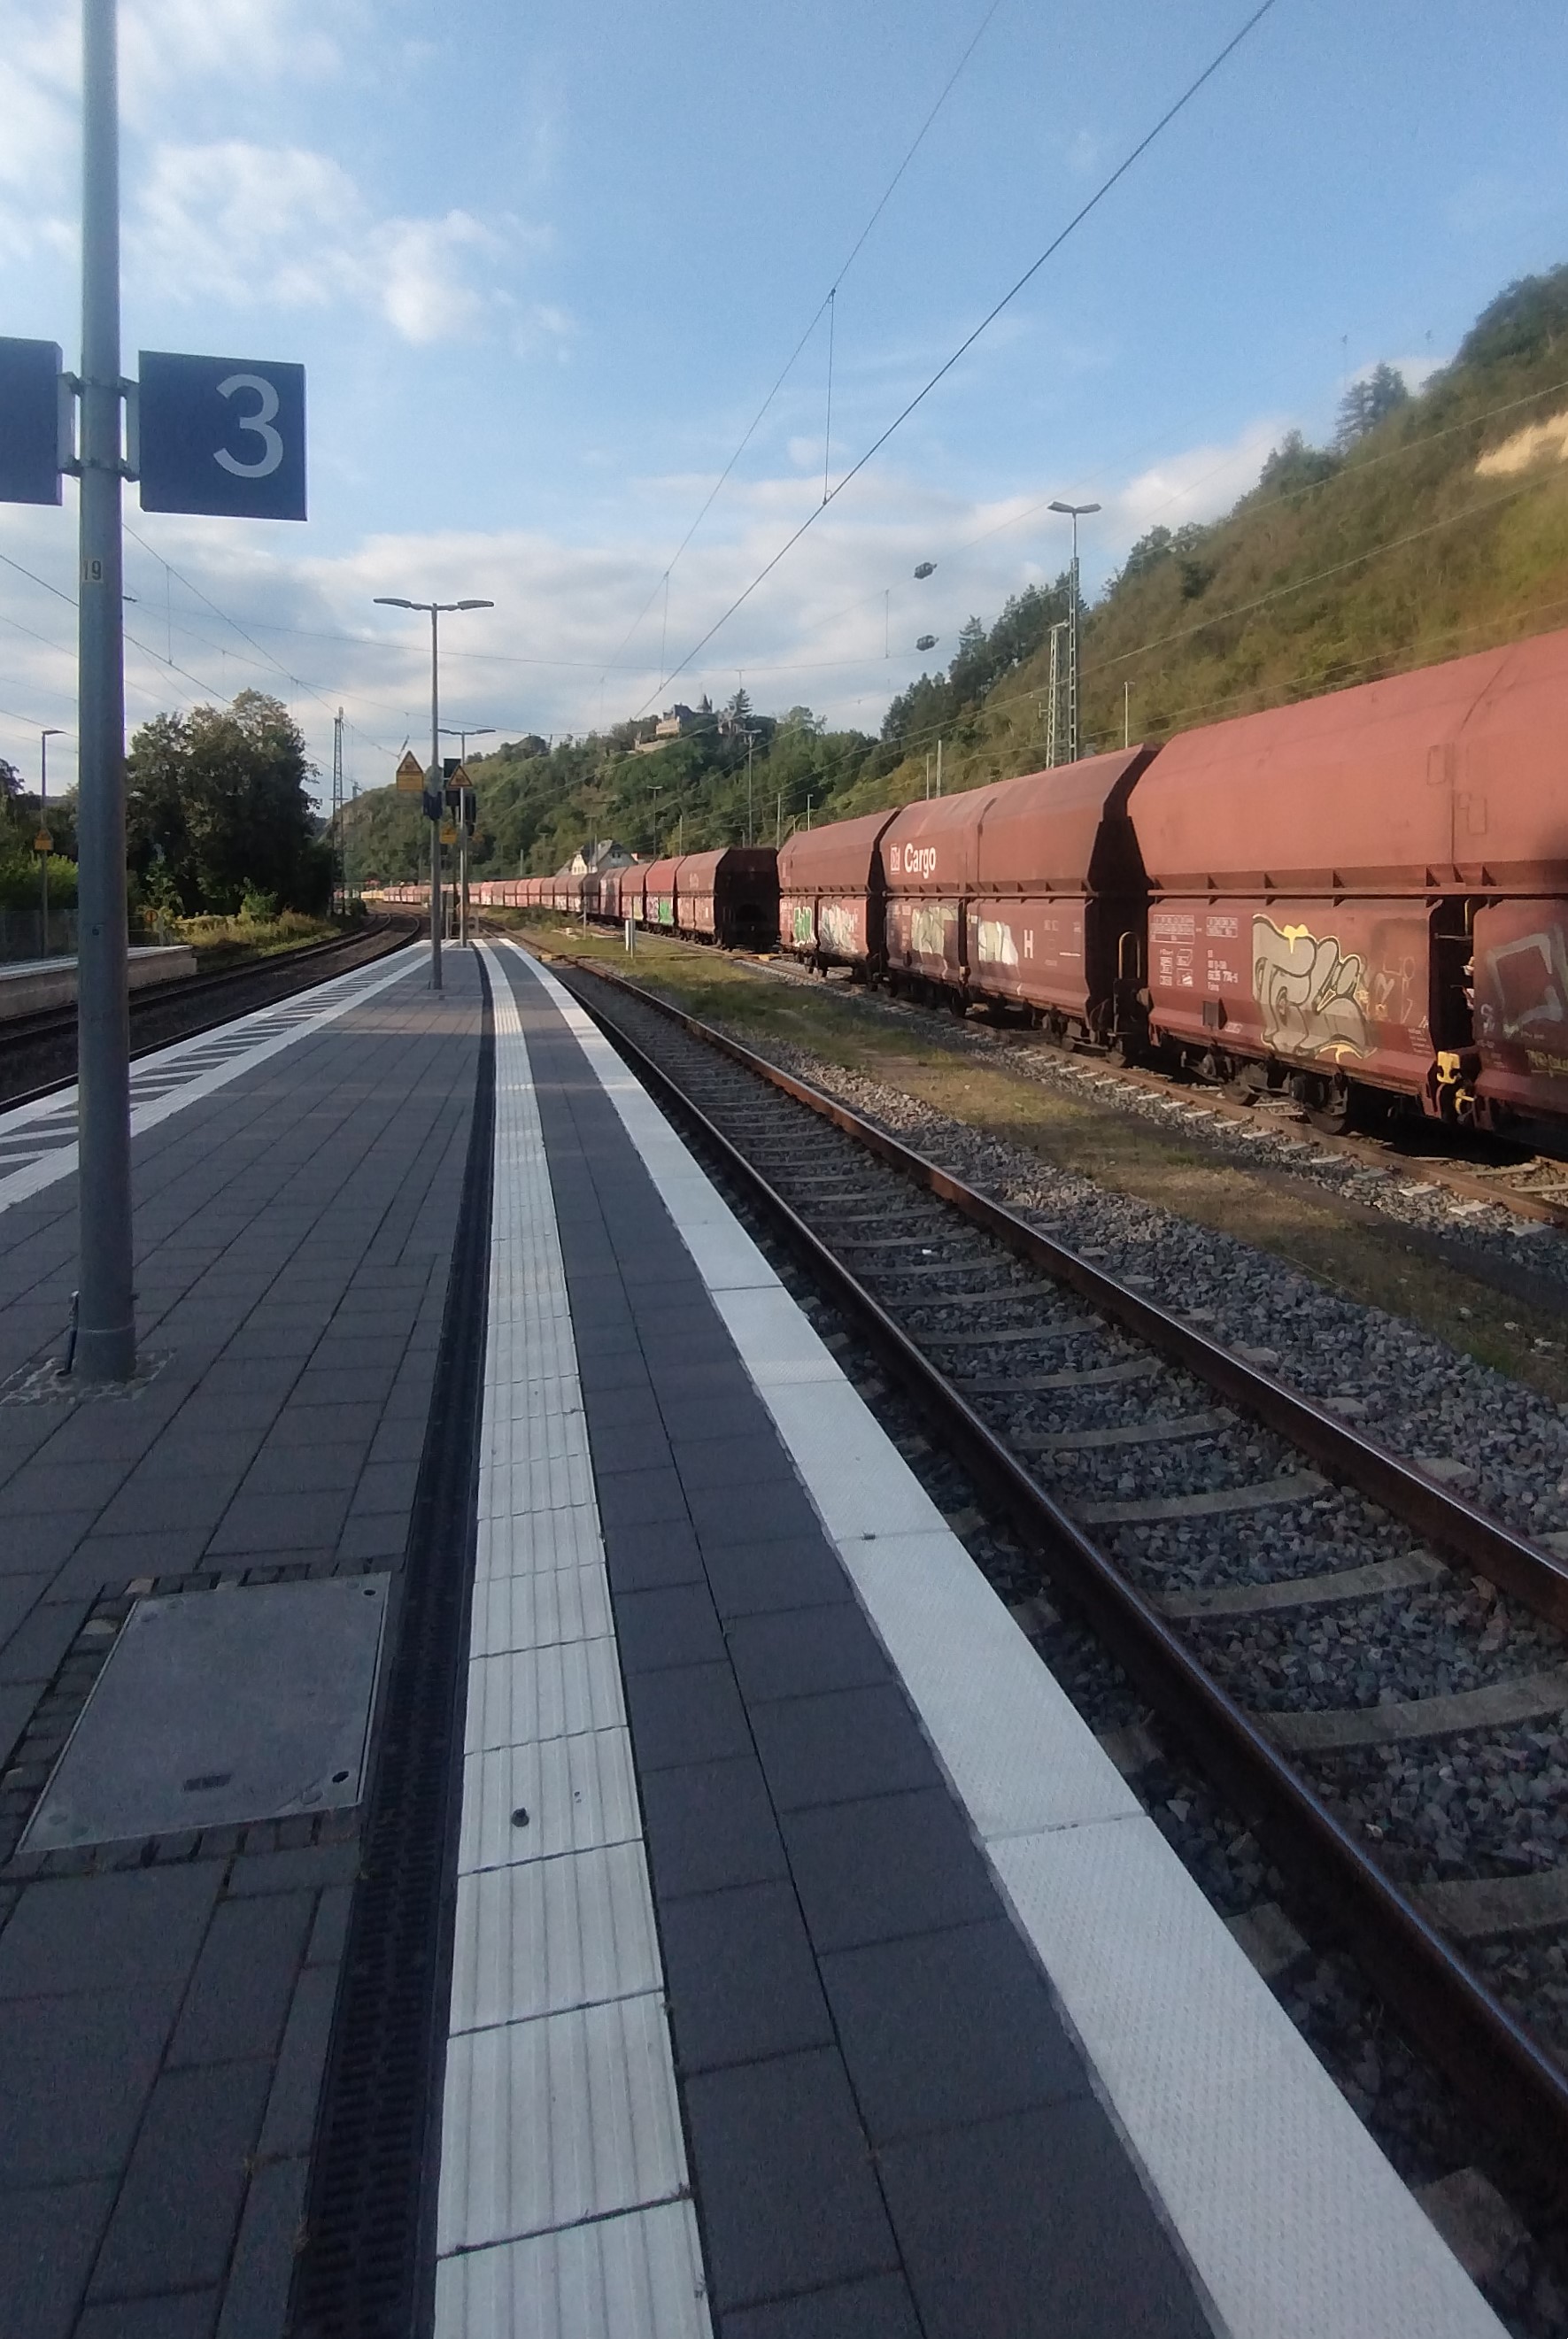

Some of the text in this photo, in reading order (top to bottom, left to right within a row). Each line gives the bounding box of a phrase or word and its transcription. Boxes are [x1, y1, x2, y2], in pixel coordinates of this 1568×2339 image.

[212, 374, 283, 478] 3
[84, 560, 102, 581] 19
[904, 843, 937, 879] Cargo
[1023, 929, 1034, 959] H
